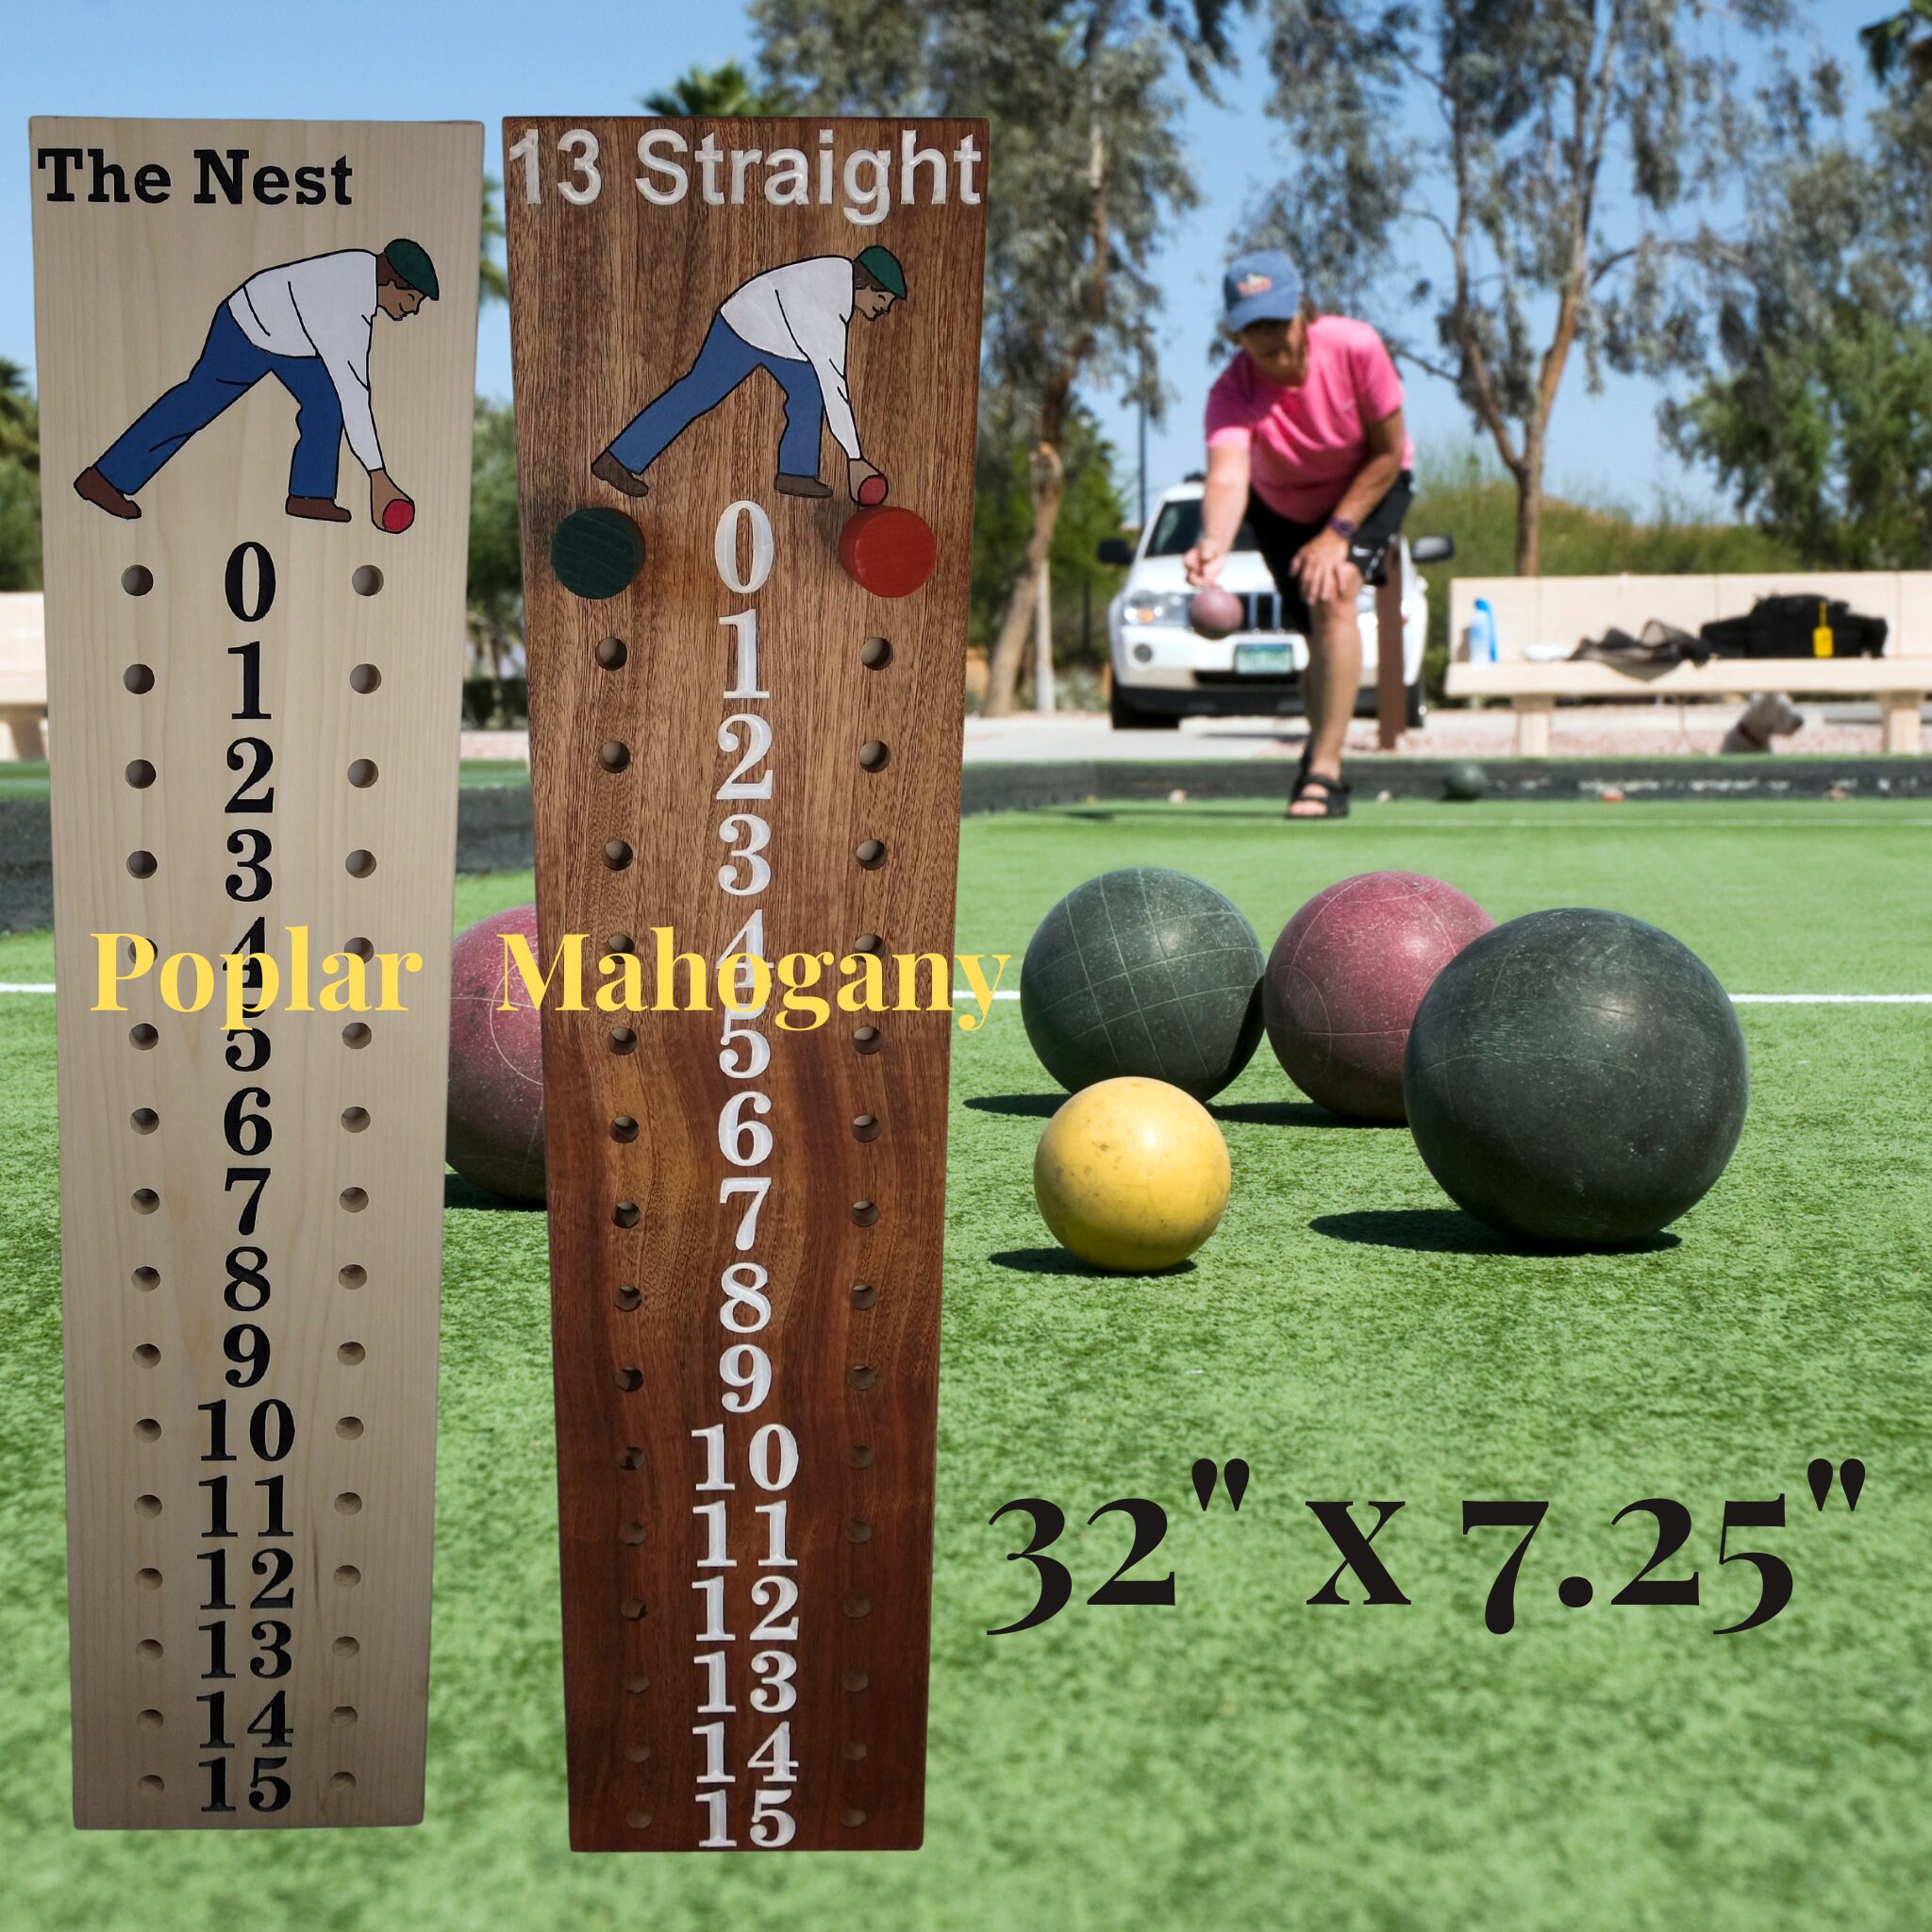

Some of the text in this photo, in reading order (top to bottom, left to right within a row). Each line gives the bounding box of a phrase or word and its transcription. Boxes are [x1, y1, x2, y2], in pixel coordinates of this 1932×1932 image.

[37, 147, 353, 206] The Nest
[509, 128, 982, 226] 13 Straight
[714, 499, 774, 595] 0
[225, 541, 276, 623] 0
[227, 641, 272, 720] 1
[718, 608, 770, 700] 1
[225, 737, 275, 814] 2
[715, 712, 774, 802] 2
[225, 828, 273, 903] 3
[717, 813, 771, 897] 3
[719, 1002, 771, 1079] 5
[224, 1087, 273, 1157] 6
[717, 1091, 774, 1168] 6
[225, 1167, 272, 1236] 7
[719, 1176, 772, 1251] 7
[224, 1246, 271, 1312] 8
[718, 1261, 773, 1335] 8
[224, 1324, 271, 1389] 9
[719, 1343, 773, 1413] 9
[197, 1398, 296, 1462] 10
[691, 1423, 799, 1491] 10
[198, 1474, 294, 1538] 11
[692, 1500, 798, 1567] 11
[196, 1547, 294, 1610] 12
[691, 1575, 799, 1641] 12
[198, 1620, 292, 1679] 13
[693, 1650, 797, 1713] 13
[195, 1690, 294, 1750] 14
[691, 1722, 799, 1783] 14
[197, 1756, 291, 1813] 15
[695, 1790, 796, 1848] 15
